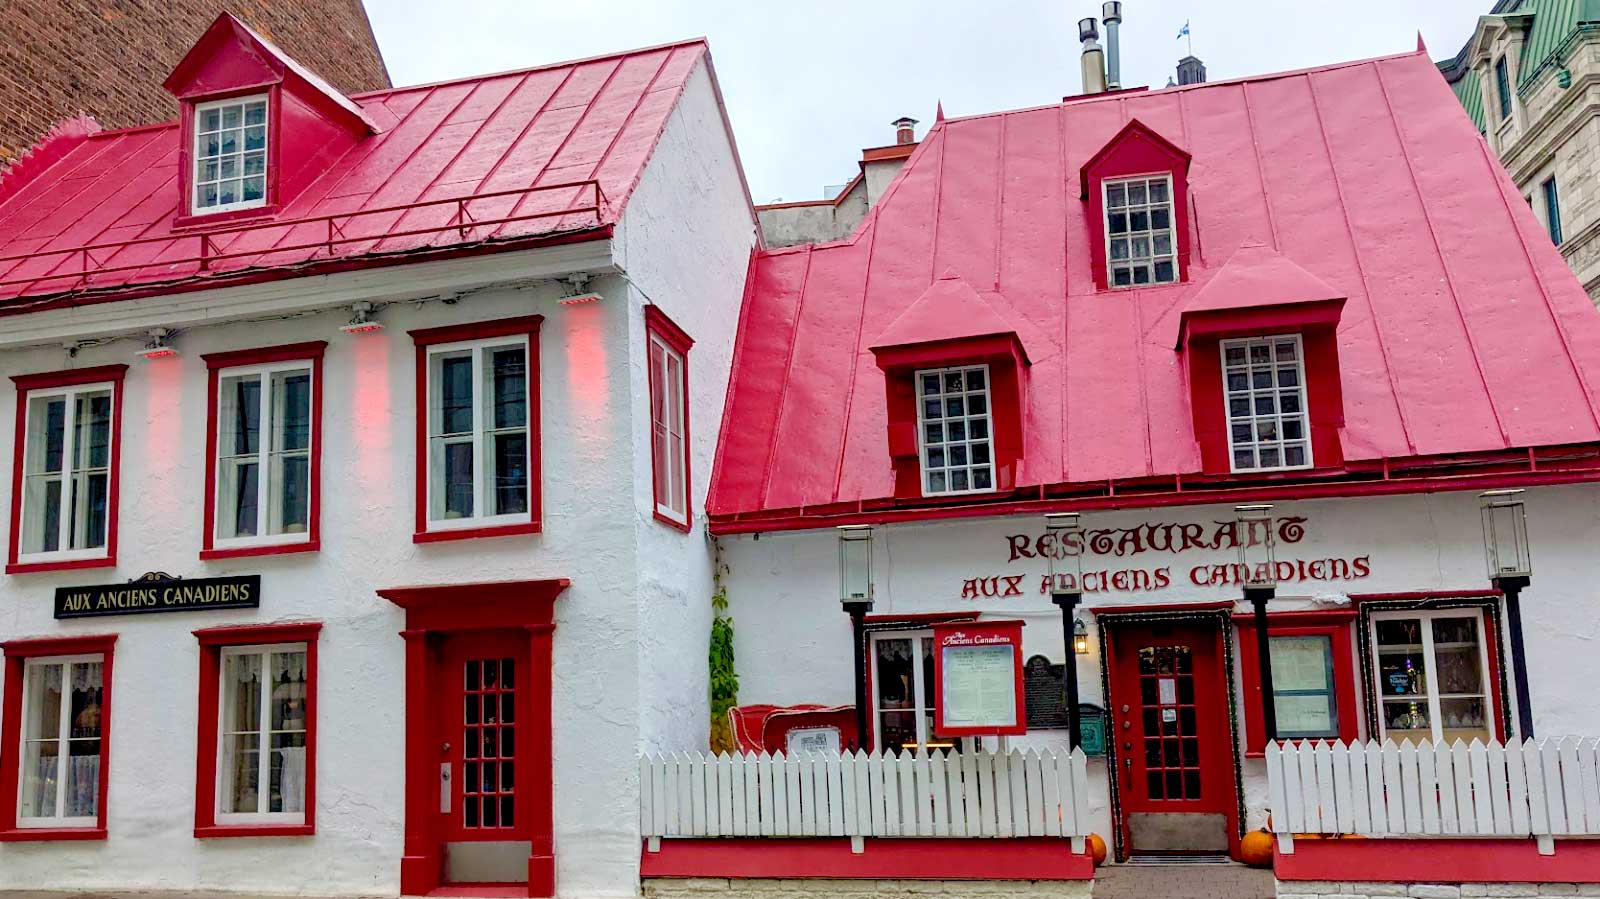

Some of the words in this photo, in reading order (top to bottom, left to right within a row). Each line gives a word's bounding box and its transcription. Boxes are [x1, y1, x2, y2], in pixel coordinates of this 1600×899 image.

[1005, 516, 1308, 563] RESTAURANT
[961, 573, 1026, 600] AUX
[1039, 566, 1171, 595] ANCIENS
[1189, 554, 1371, 588] CANADIENS
[63, 592, 91, 611] AUX
[96, 588, 157, 610] ANCIENS
[163, 583, 250, 605] CANADIENS
[942, 635, 973, 646] Anciens
[974, 634, 1010, 644] Canadiens
